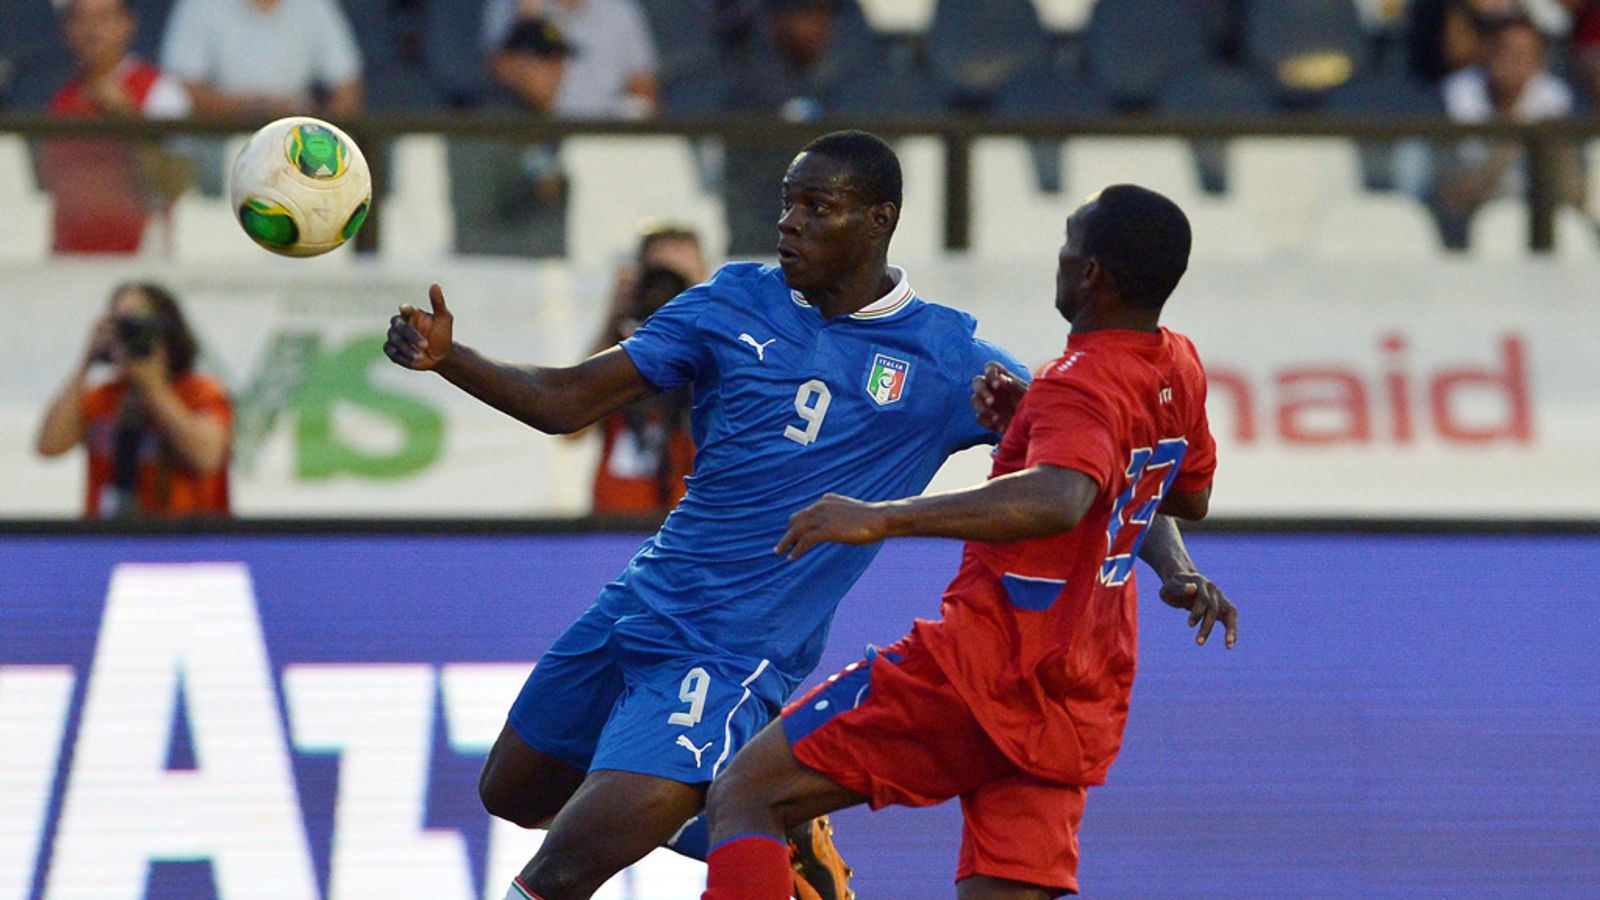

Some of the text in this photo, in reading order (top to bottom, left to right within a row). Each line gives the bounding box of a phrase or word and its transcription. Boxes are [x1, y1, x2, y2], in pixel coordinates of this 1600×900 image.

[878, 358, 904, 370] ITALIA
[783, 379, 832, 446] 9
[667, 667, 711, 728] 9
